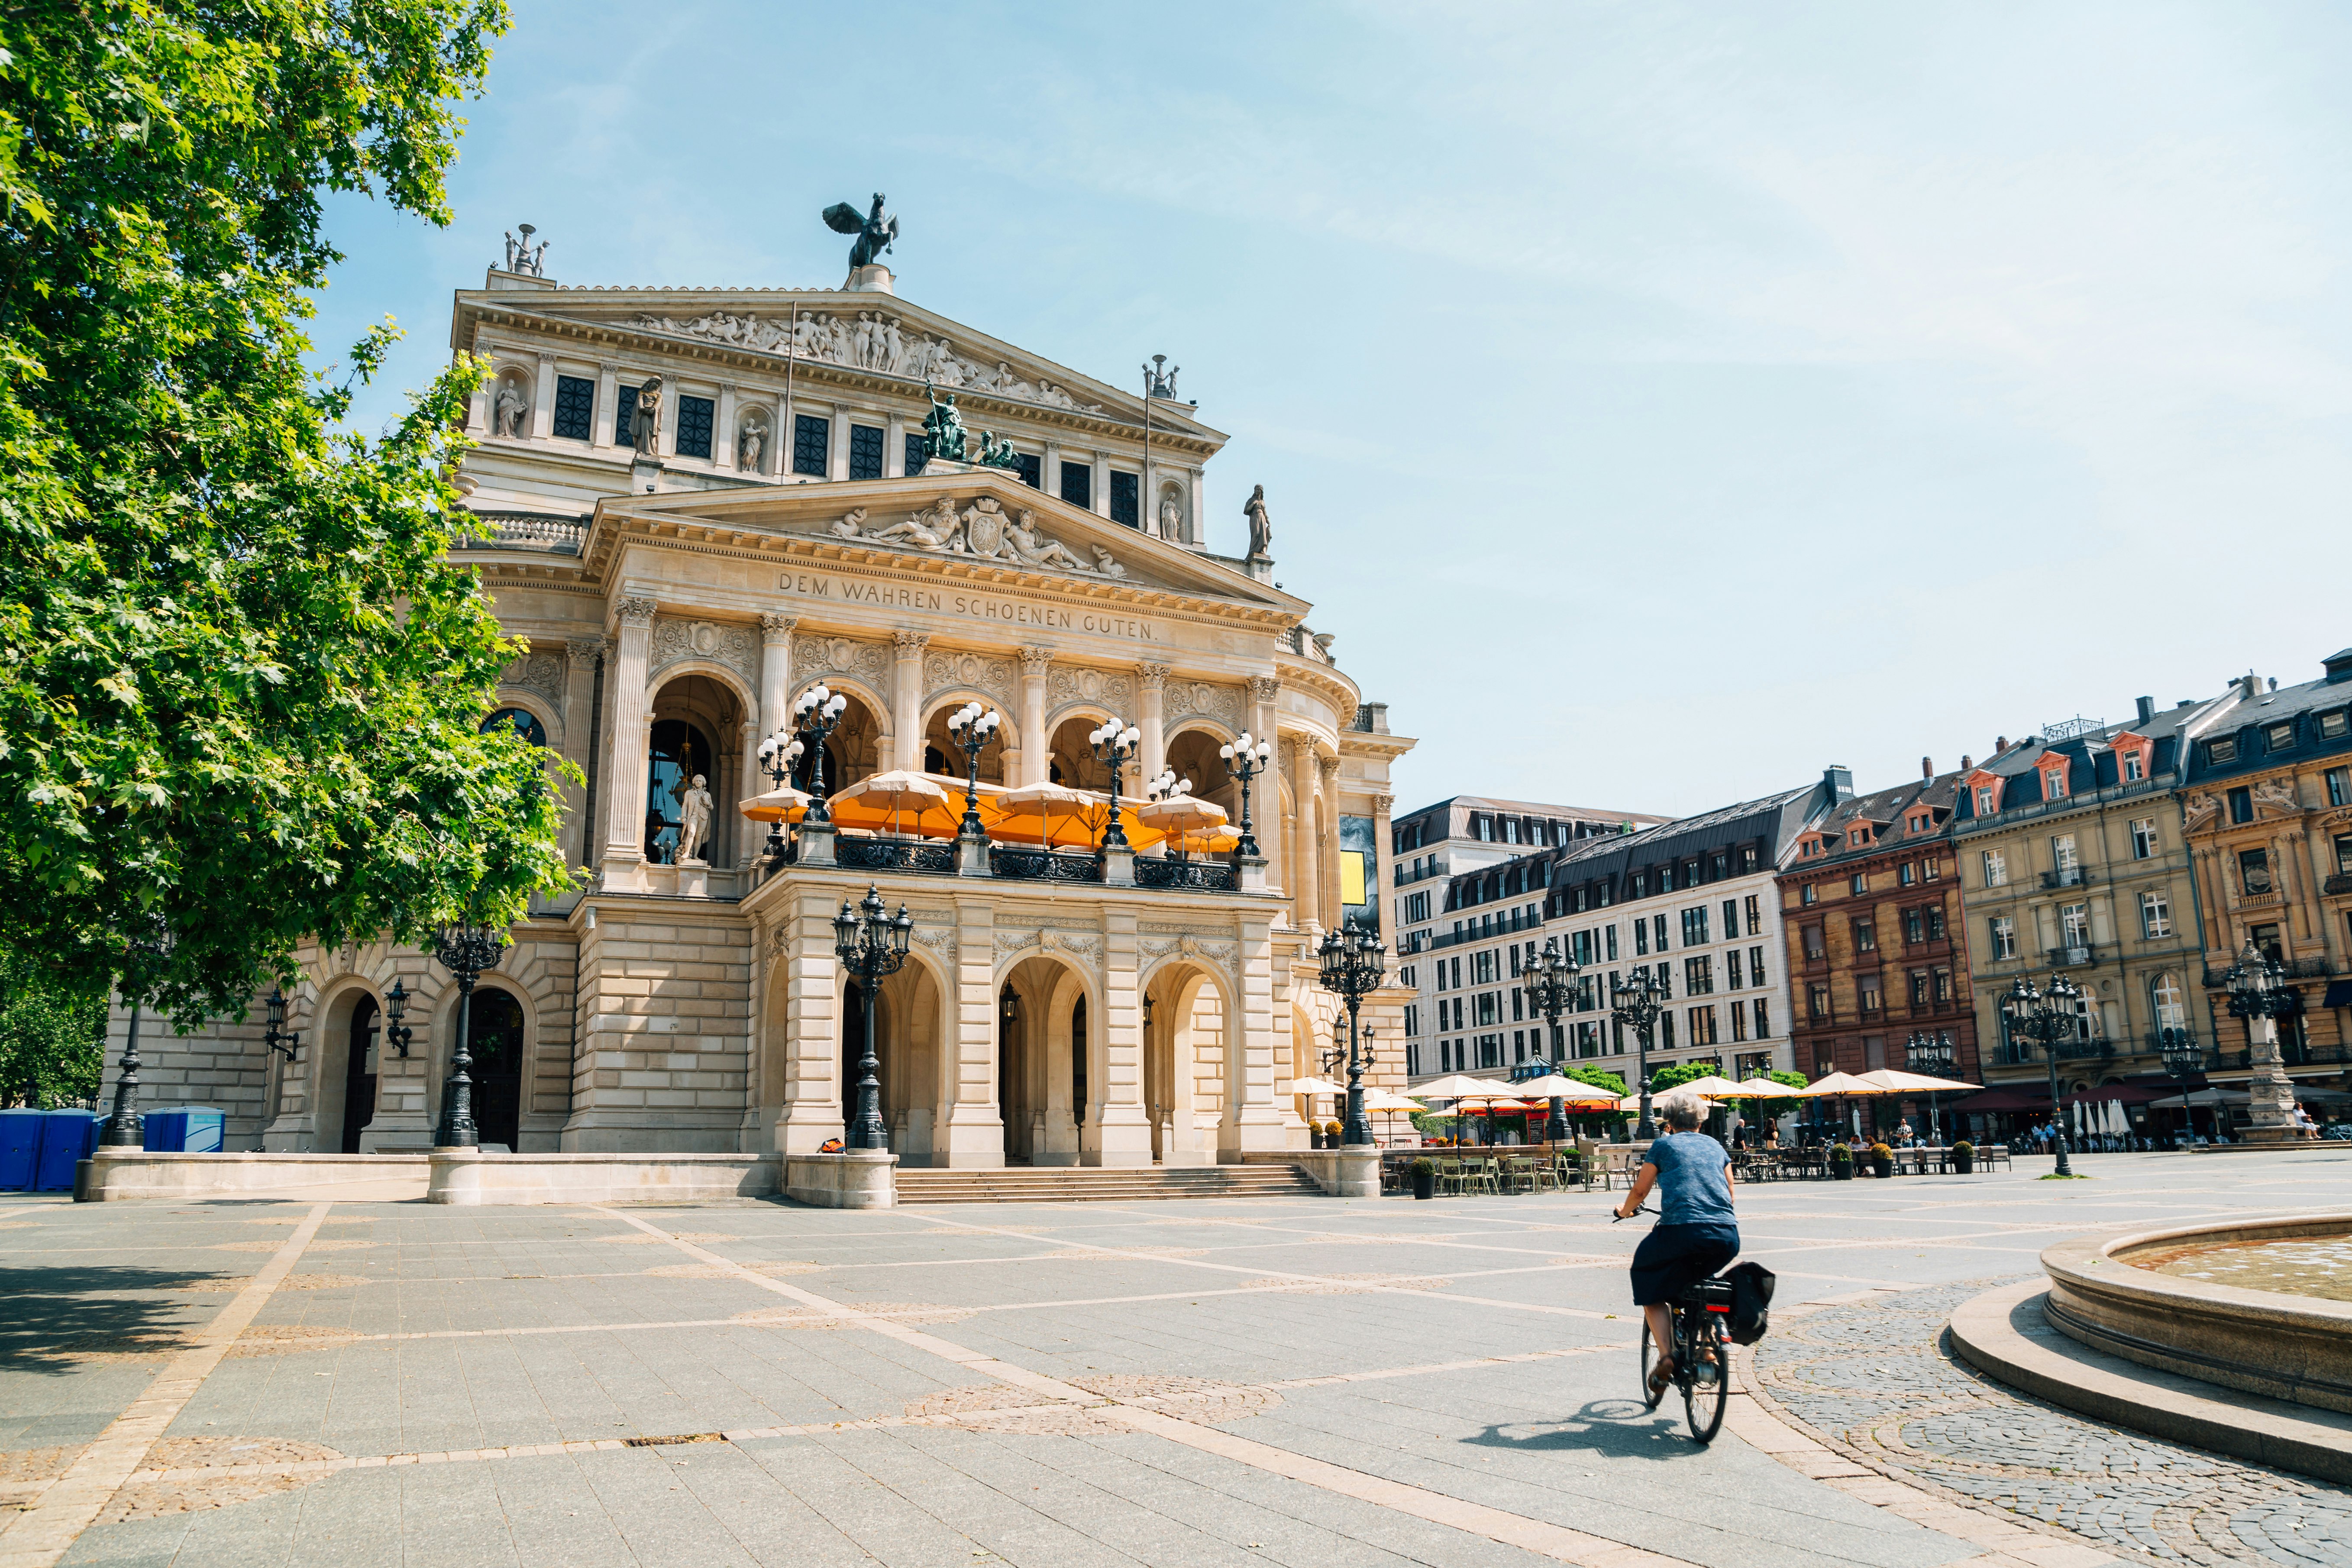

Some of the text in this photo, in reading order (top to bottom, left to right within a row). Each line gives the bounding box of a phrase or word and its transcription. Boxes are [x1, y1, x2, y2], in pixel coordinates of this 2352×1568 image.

[779, 573, 1158, 640] DEM WAHREN SCHOENEN GUTEN.
